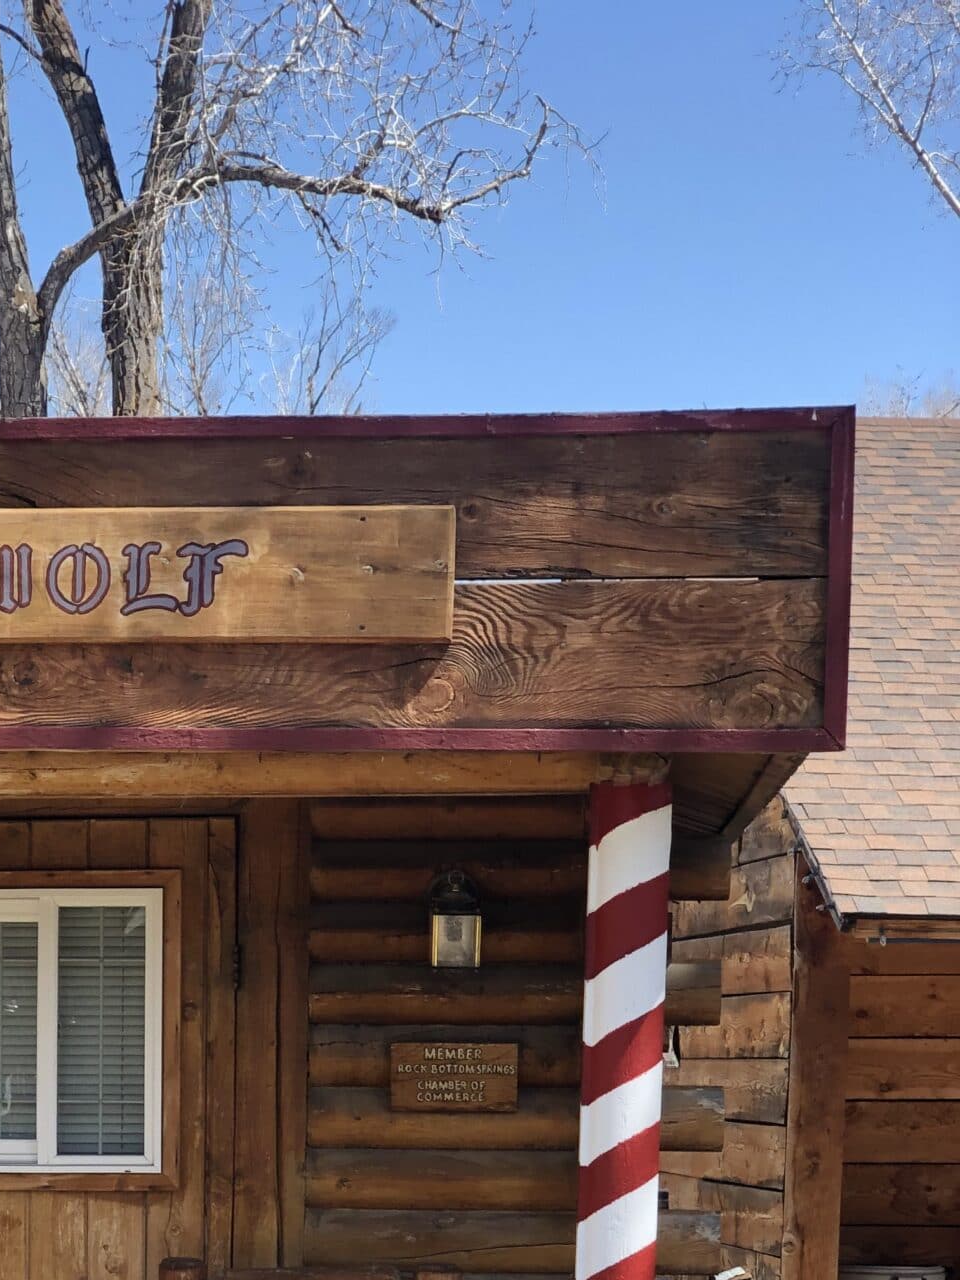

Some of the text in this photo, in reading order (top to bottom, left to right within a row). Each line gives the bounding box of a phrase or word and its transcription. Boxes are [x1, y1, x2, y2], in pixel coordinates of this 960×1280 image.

[424, 1047, 482, 1060] MEMBER
[398, 1064, 515, 1074] ROCK BOTTOM SPRINGS
[417, 1080, 486, 1090] CHAMBER OF
[417, 1092, 484, 1102] COMMERCE
